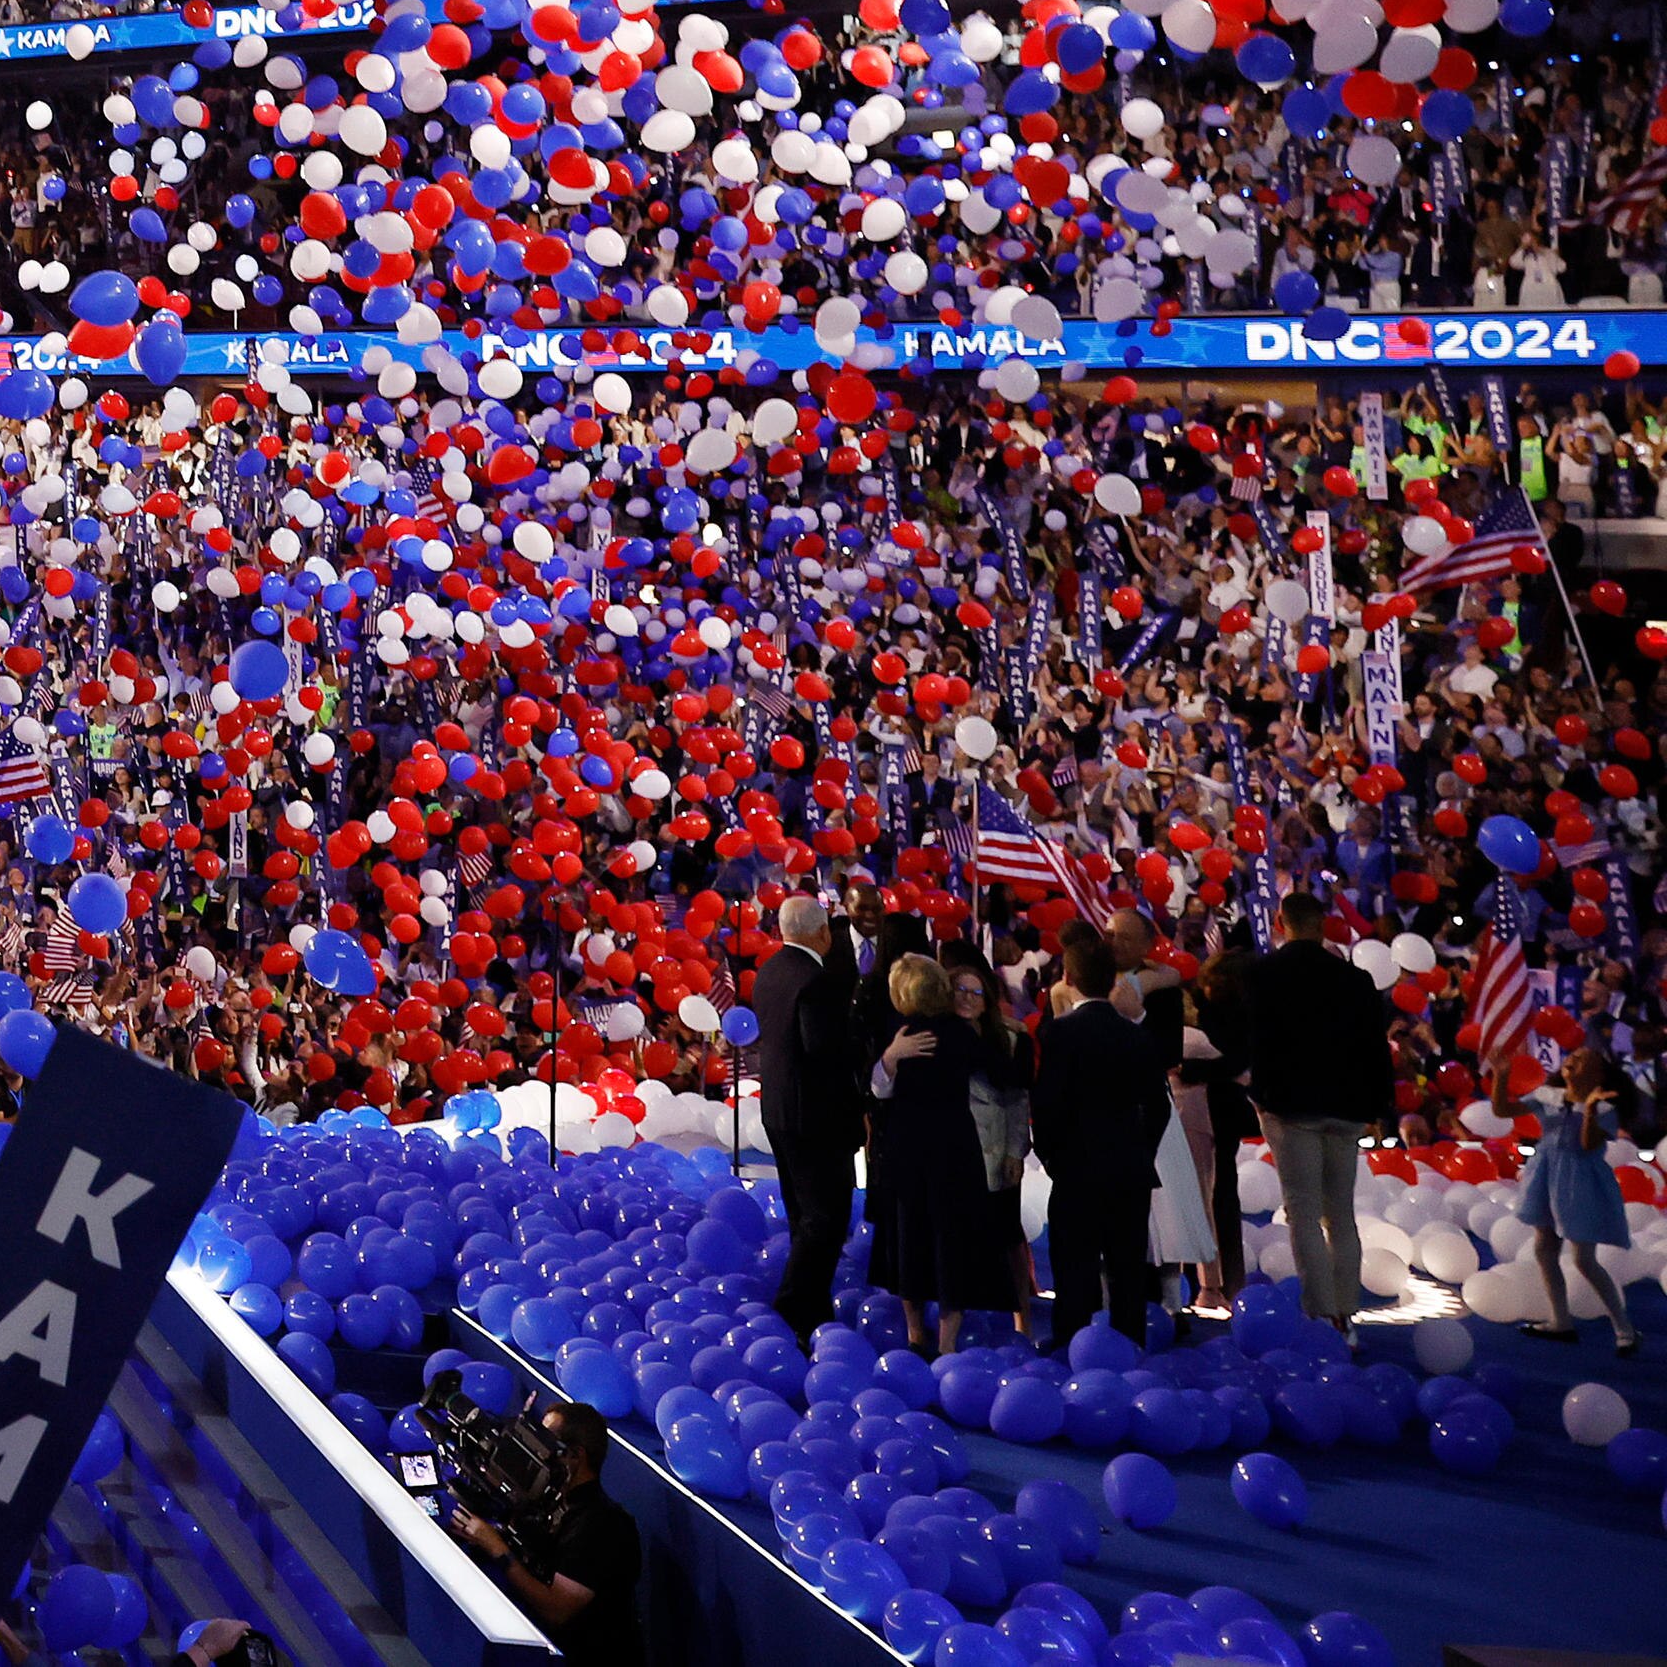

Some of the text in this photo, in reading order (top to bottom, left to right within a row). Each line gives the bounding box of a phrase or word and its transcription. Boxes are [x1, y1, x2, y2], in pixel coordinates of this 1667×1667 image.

[17, 25, 110, 51] KAMA
[227, 337, 350, 364] KALA
[1434, 317, 1596, 360] 2024
[97, 590, 109, 651] KAMALA
